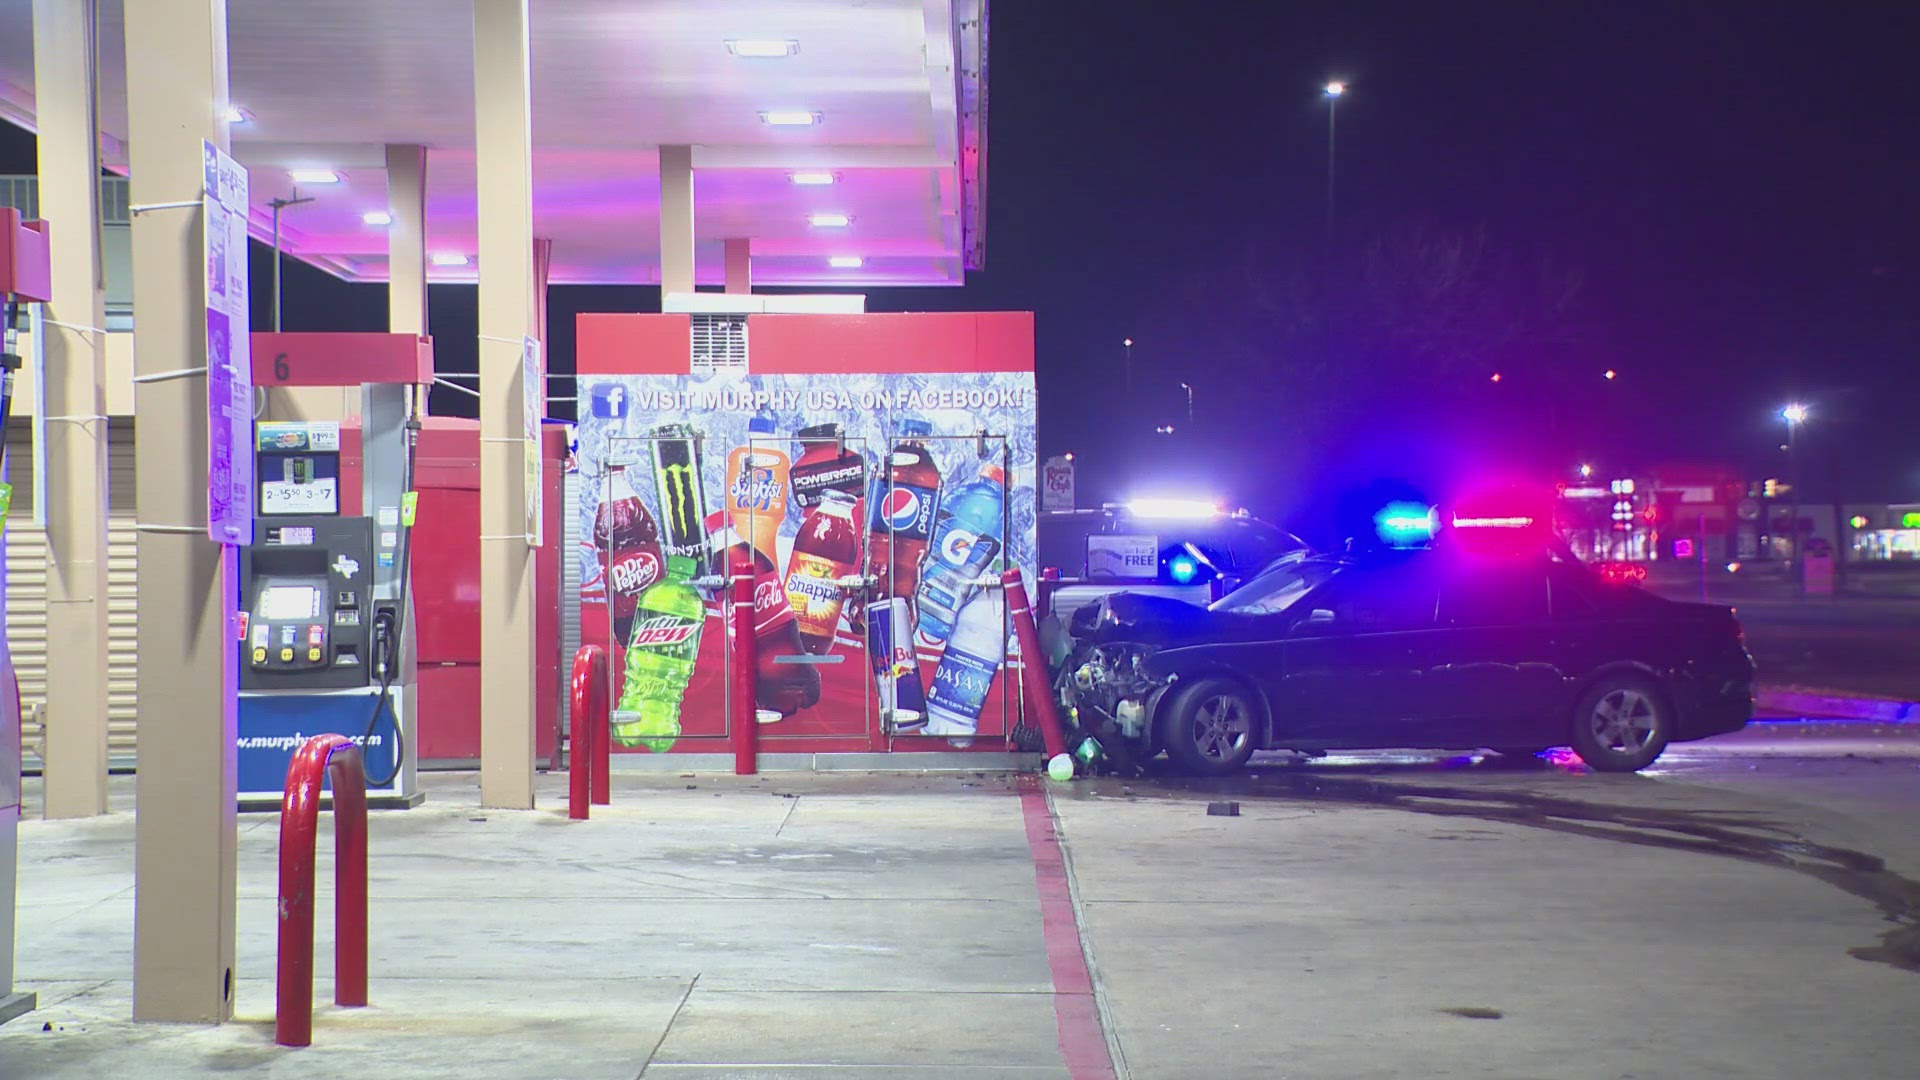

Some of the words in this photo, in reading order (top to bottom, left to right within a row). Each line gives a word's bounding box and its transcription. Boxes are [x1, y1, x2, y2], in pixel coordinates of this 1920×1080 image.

[275, 352, 289, 381] 6
[637, 391, 694, 410] VISIT
[703, 391, 800, 411] MURPHY
[807, 391, 851, 410] USA
[860, 390, 892, 410] ON
[896, 389, 1024, 409] FACEBOOK!
[794, 465, 863, 487] POWERADE
[917, 493, 932, 534] pepsi
[941, 529, 979, 566] G
[1125, 555, 1155, 566] FREE
[787, 574, 842, 602] Snapple
[935, 664, 991, 697] DASANI
